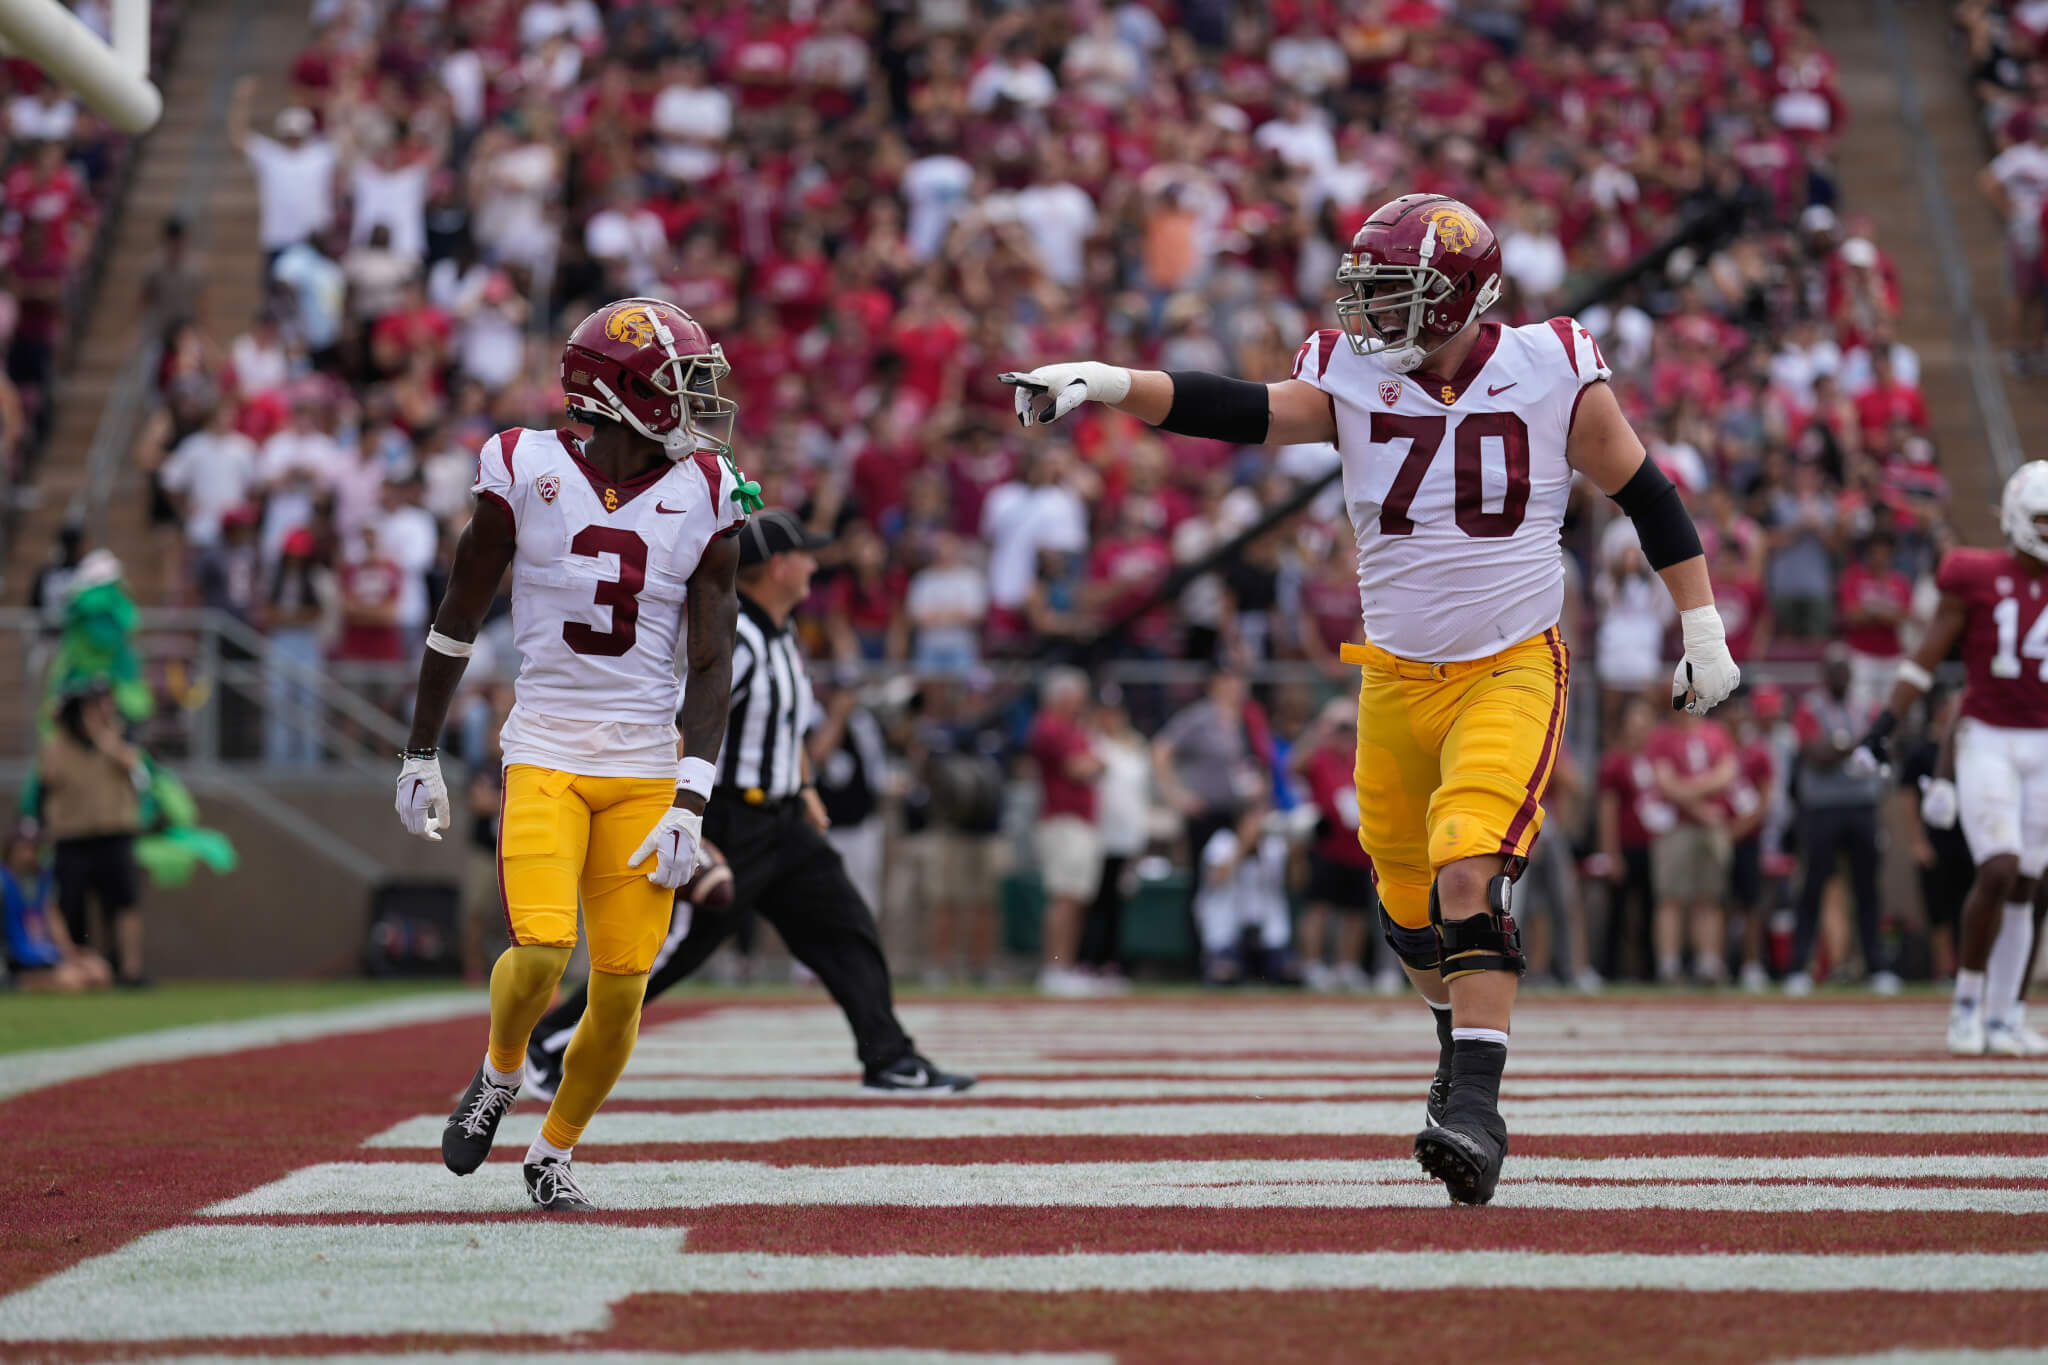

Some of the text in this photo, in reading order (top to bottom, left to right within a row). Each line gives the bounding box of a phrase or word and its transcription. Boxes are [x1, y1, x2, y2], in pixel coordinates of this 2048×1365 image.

[1384, 391, 1396, 402] 12
[543, 487, 554, 499] 12
[1370, 411, 1530, 537] 70
[562, 524, 648, 657] 3
